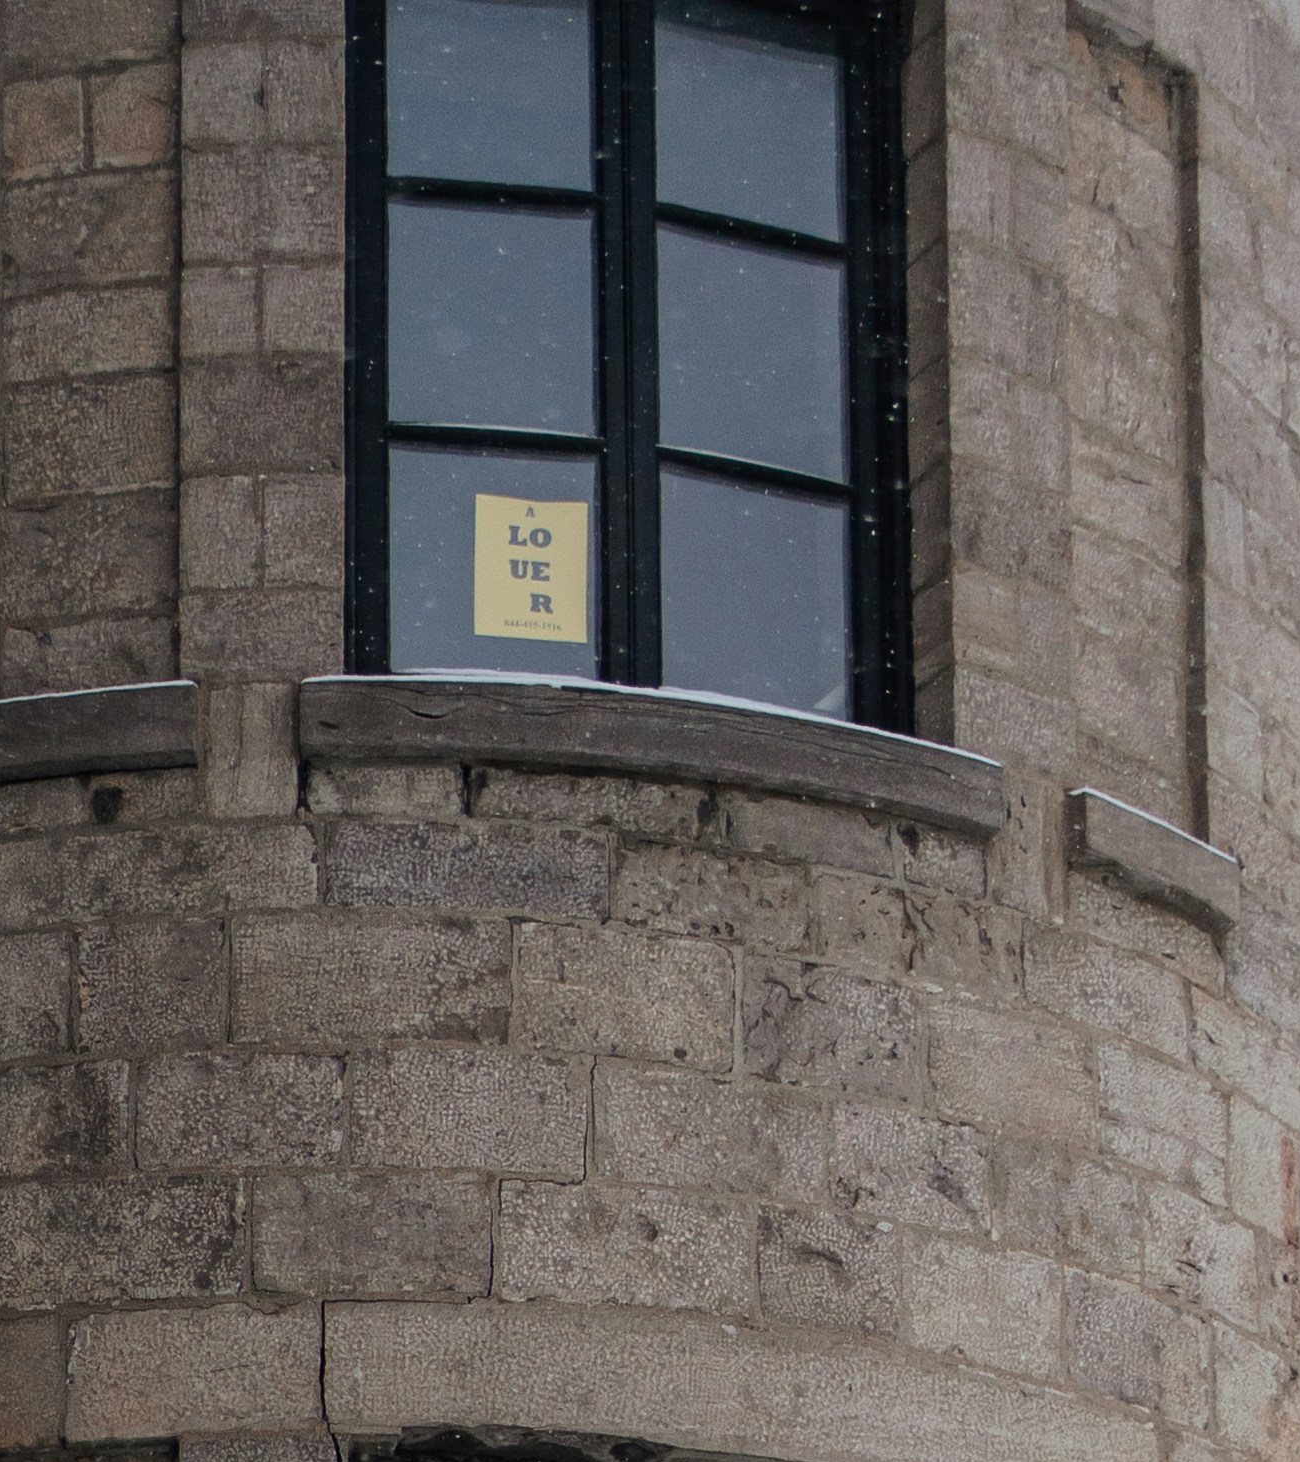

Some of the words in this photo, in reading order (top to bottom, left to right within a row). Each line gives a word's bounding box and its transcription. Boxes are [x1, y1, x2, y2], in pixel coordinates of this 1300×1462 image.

[508, 525, 552, 548] LO
[509, 559, 550, 582] UE
[529, 593, 553, 615] R
